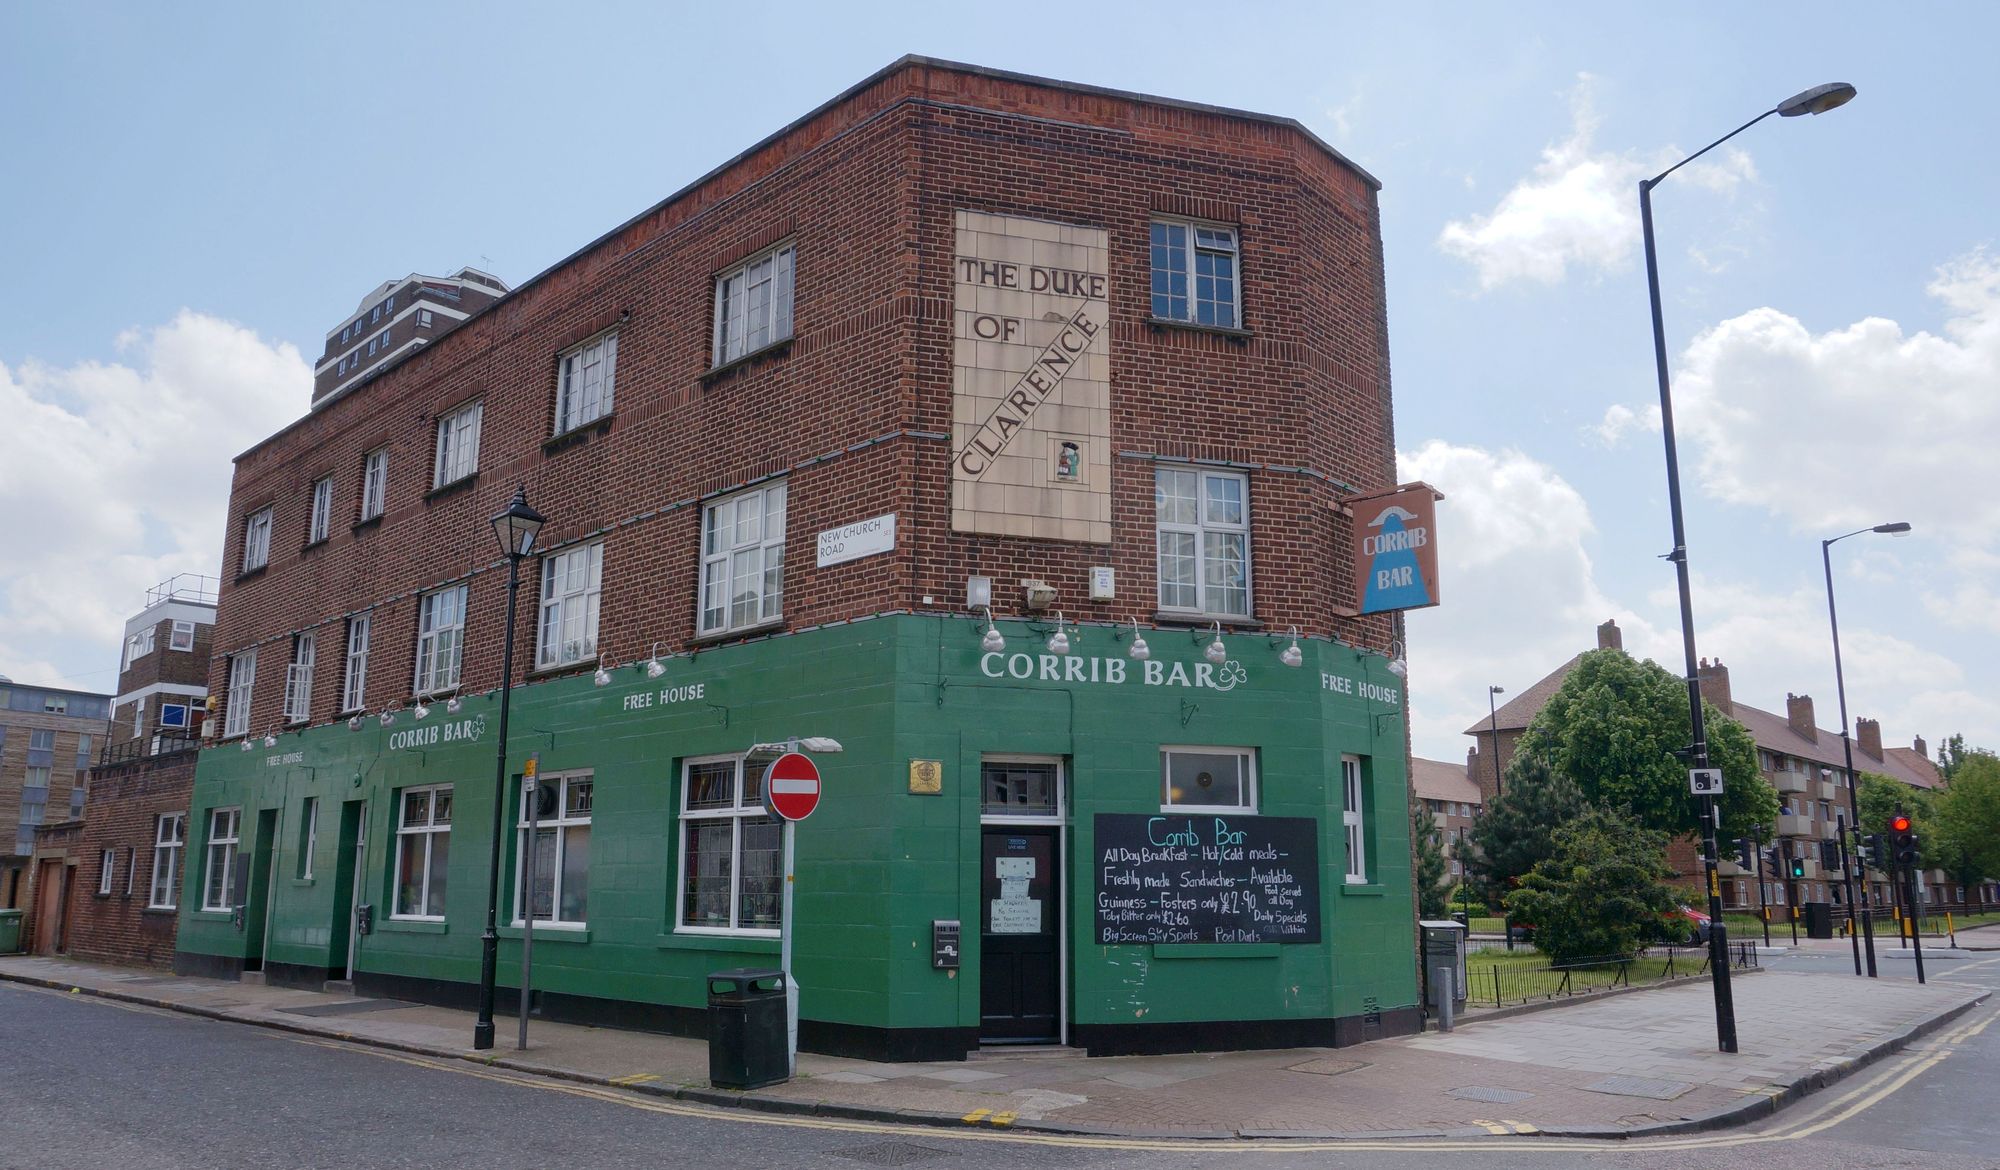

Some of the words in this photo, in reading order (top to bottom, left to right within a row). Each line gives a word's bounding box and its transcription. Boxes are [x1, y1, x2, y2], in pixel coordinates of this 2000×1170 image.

[959, 258, 1018, 289] THE
[1029, 267, 1106, 300] DUKE
[973, 315, 1020, 342] OF
[960, 312, 1100, 475] CLARENCE
[820, 529, 842, 545] NEW
[843, 520, 881, 539] CHURCH
[1363, 527, 1428, 556] CORRIB
[820, 542, 845, 558] ROAD
[1377, 566, 1414, 590] BAR
[980, 652, 1127, 684] CORRIB
[1144, 660, 1217, 687] BAR
[623, 692, 653, 711] FREE
[660, 683, 705, 705] HOUSE
[1321, 672, 1353, 695] FREE
[1358, 681, 1398, 705] HOUSE
[389, 725, 439, 750] CORRIB
[443, 720, 472, 742] BAR
[266, 755, 281, 767] FREE
[282, 751, 304, 765] HOUSE
[1148, 816, 1200, 846] Corrib
[1215, 817, 1248, 846] Bar
[1103, 848, 1119, 863] All
[1120, 847, 1141, 867] Day
[1249, 843, 1278, 860] meals
[1104, 866, 1141, 891] Freshly
[1144, 872, 1171, 888] made
[1180, 869, 1235, 888] Sandwiches
[1250, 866, 1293, 884] Available
[1264, 884, 1279, 895] Food
[1098, 891, 1147, 908] Guinness
[1160, 891, 1197, 910] Fosters
[1200, 896, 1219, 913] only
[1268, 896, 1278, 905] all
[1279, 896, 1294, 910] Day
[1098, 909, 1120, 925] Toby
[1121, 908, 1145, 921] Bitter
[1145, 910, 1161, 923] only
[1254, 909, 1274, 924] Daily
[1275, 909, 1308, 925] Specials
[1103, 926, 1119, 943] Big
[1119, 926, 1148, 942] Screen
[1147, 927, 1168, 943] Sky
[1168, 927, 1199, 943] Sports
[1215, 926, 1235, 943] Pool
[1238, 928, 1261, 942] Darts
